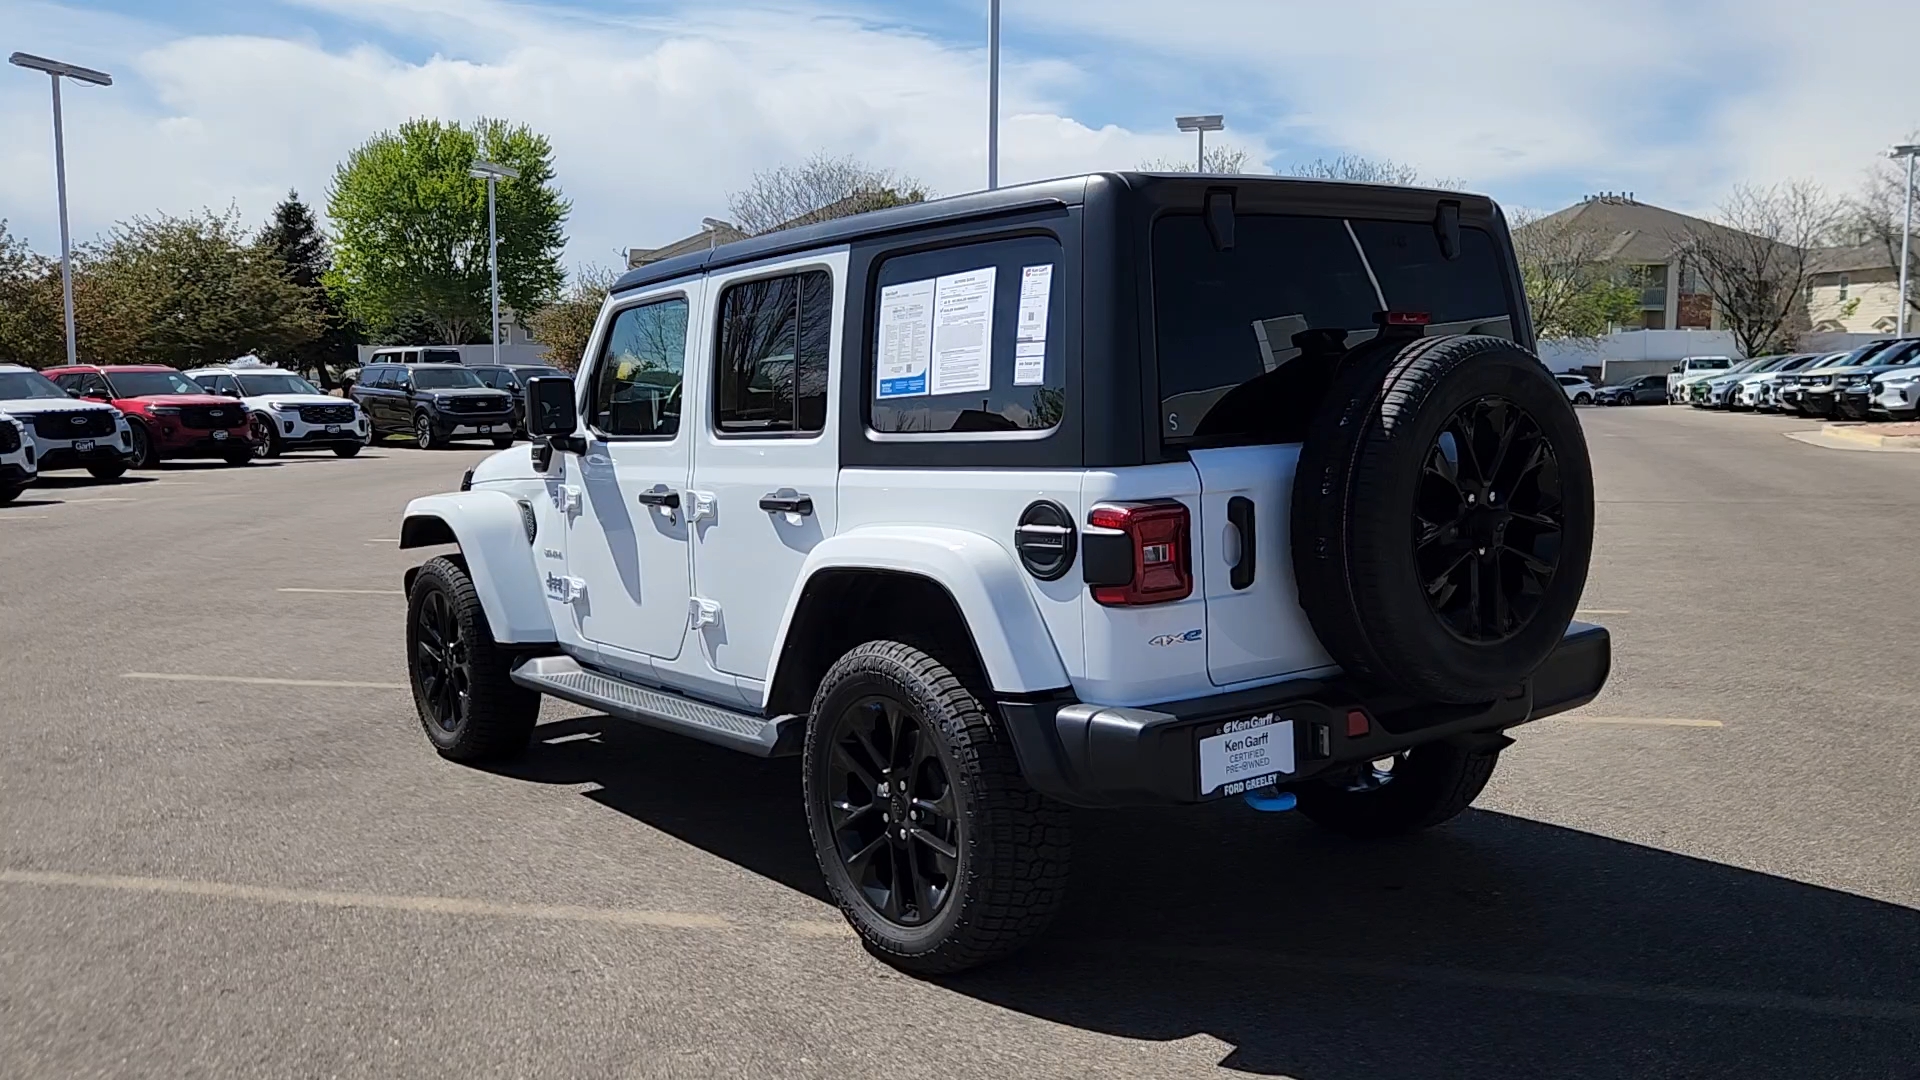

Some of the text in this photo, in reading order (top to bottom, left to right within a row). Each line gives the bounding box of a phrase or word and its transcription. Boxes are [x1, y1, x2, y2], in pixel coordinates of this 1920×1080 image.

[1232, 713, 1274, 732] Ken Garff
[1224, 732, 1269, 752] Ken Garff
[1229, 748, 1265, 763] CERTIFIED
[1225, 757, 1270, 774] PRE-OWNED
[1224, 774, 1278, 796] FORD GREELEY
